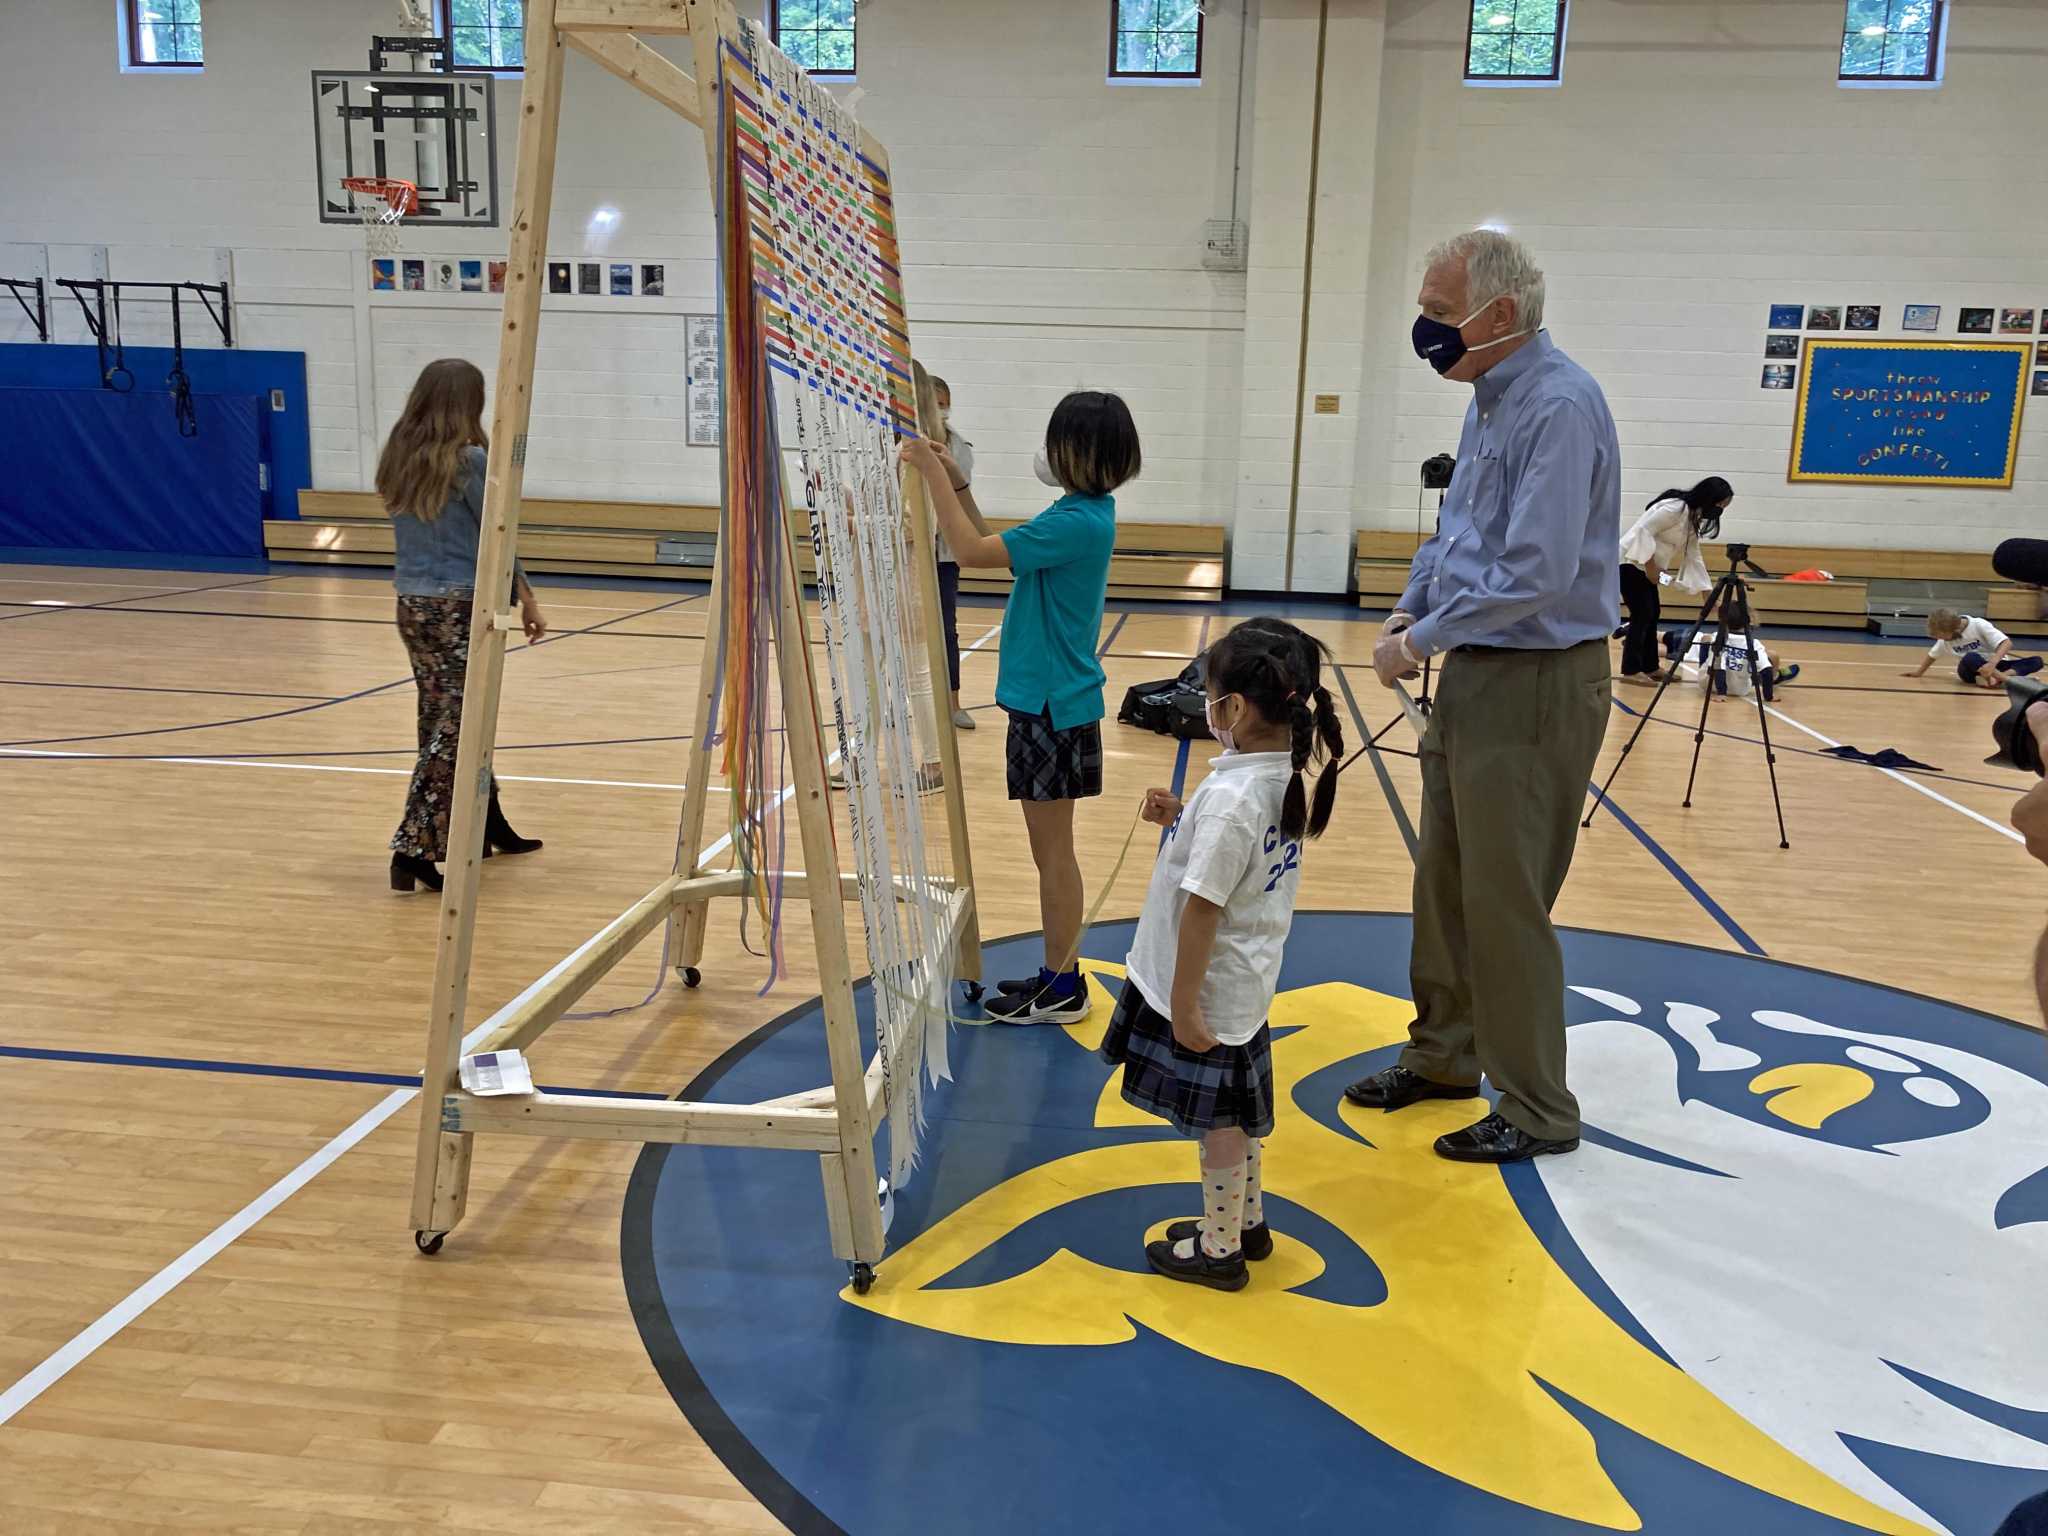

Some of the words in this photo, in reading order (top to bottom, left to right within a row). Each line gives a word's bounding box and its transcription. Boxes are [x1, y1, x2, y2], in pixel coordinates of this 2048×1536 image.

[1831, 387, 1992, 404] SPORTSMANSHIP
[1892, 425, 1926, 437] like
[1857, 443, 1950, 470] CONFETTI
[806, 479, 821, 557] GLAD
